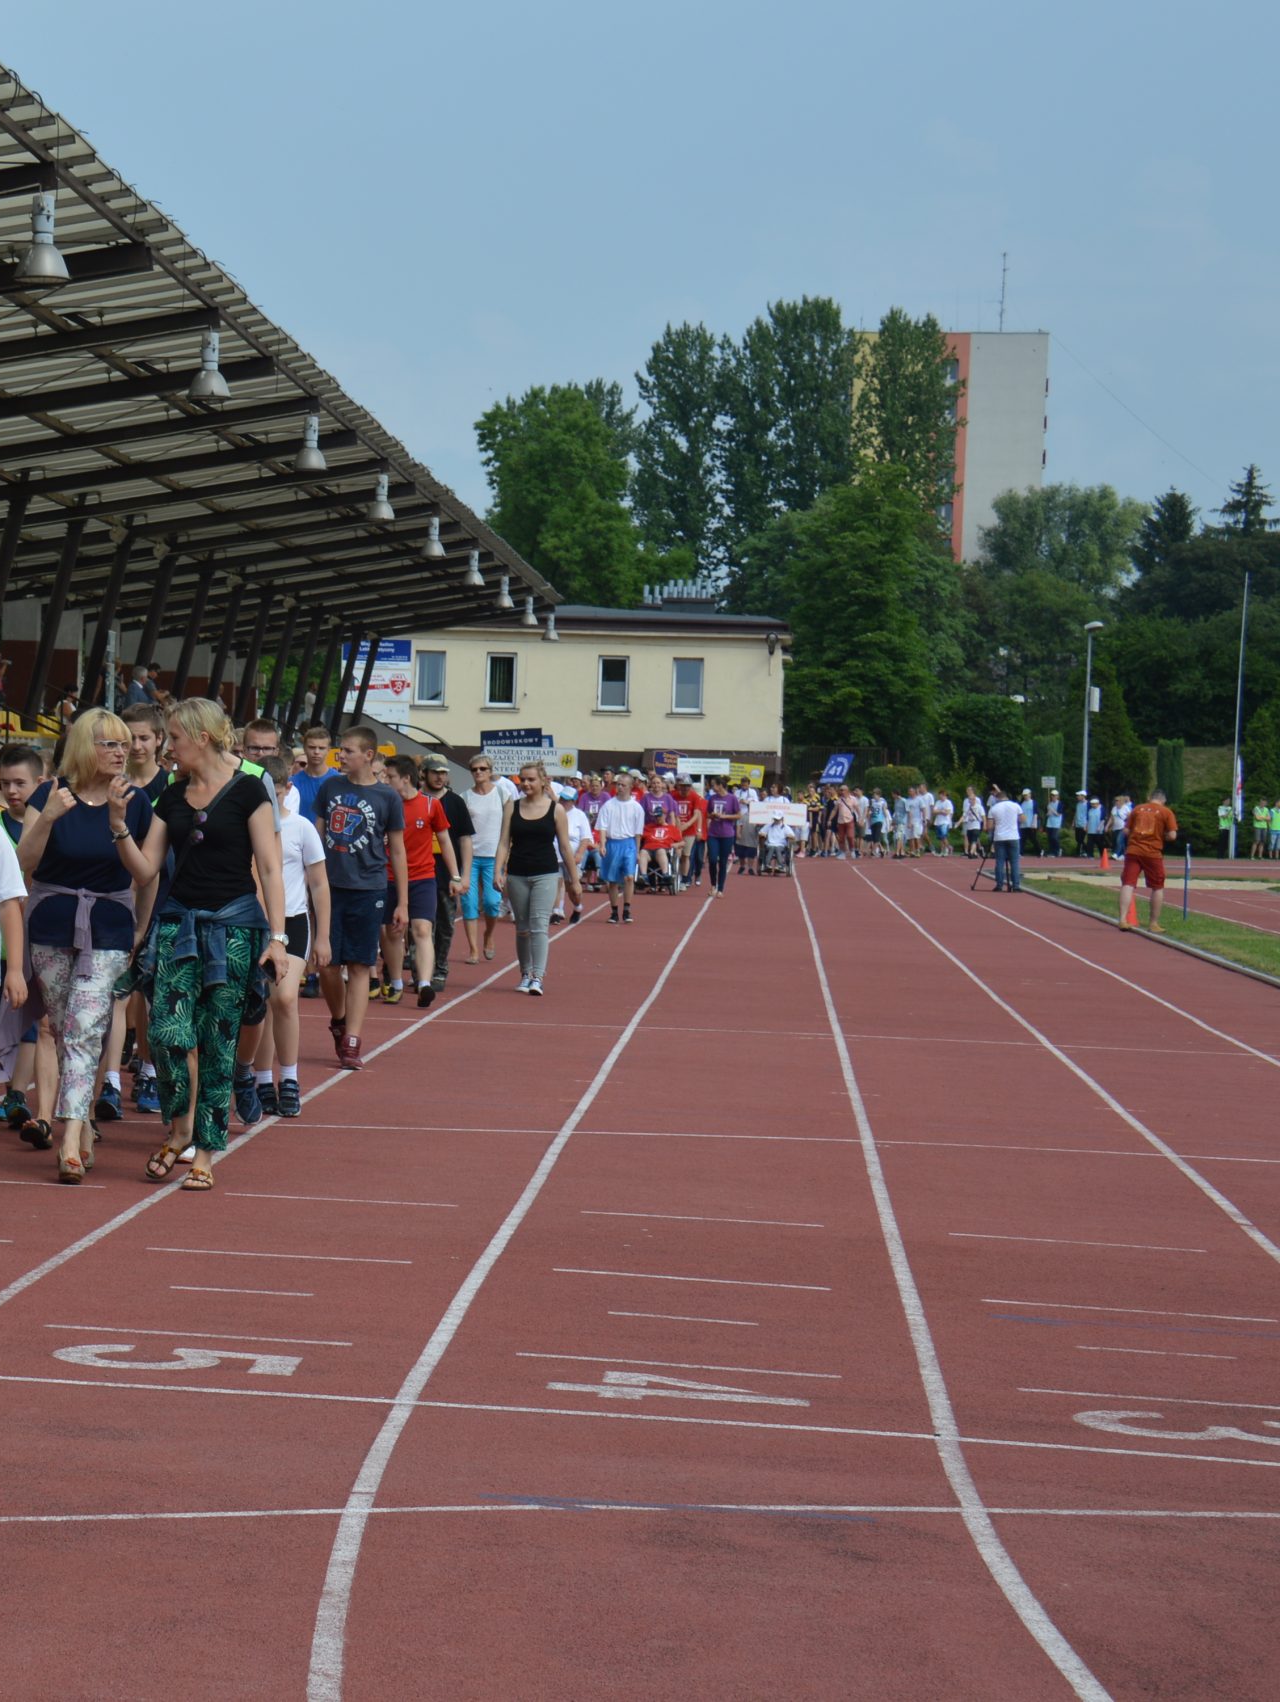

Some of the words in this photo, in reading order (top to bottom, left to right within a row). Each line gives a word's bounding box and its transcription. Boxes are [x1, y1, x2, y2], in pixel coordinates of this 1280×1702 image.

[829, 766, 843, 776] 41
[330, 810, 364, 836] 87
[53, 1344, 303, 1376] 5
[546, 1371, 811, 1407] 4
[1072, 1410, 1280, 1446] 3
